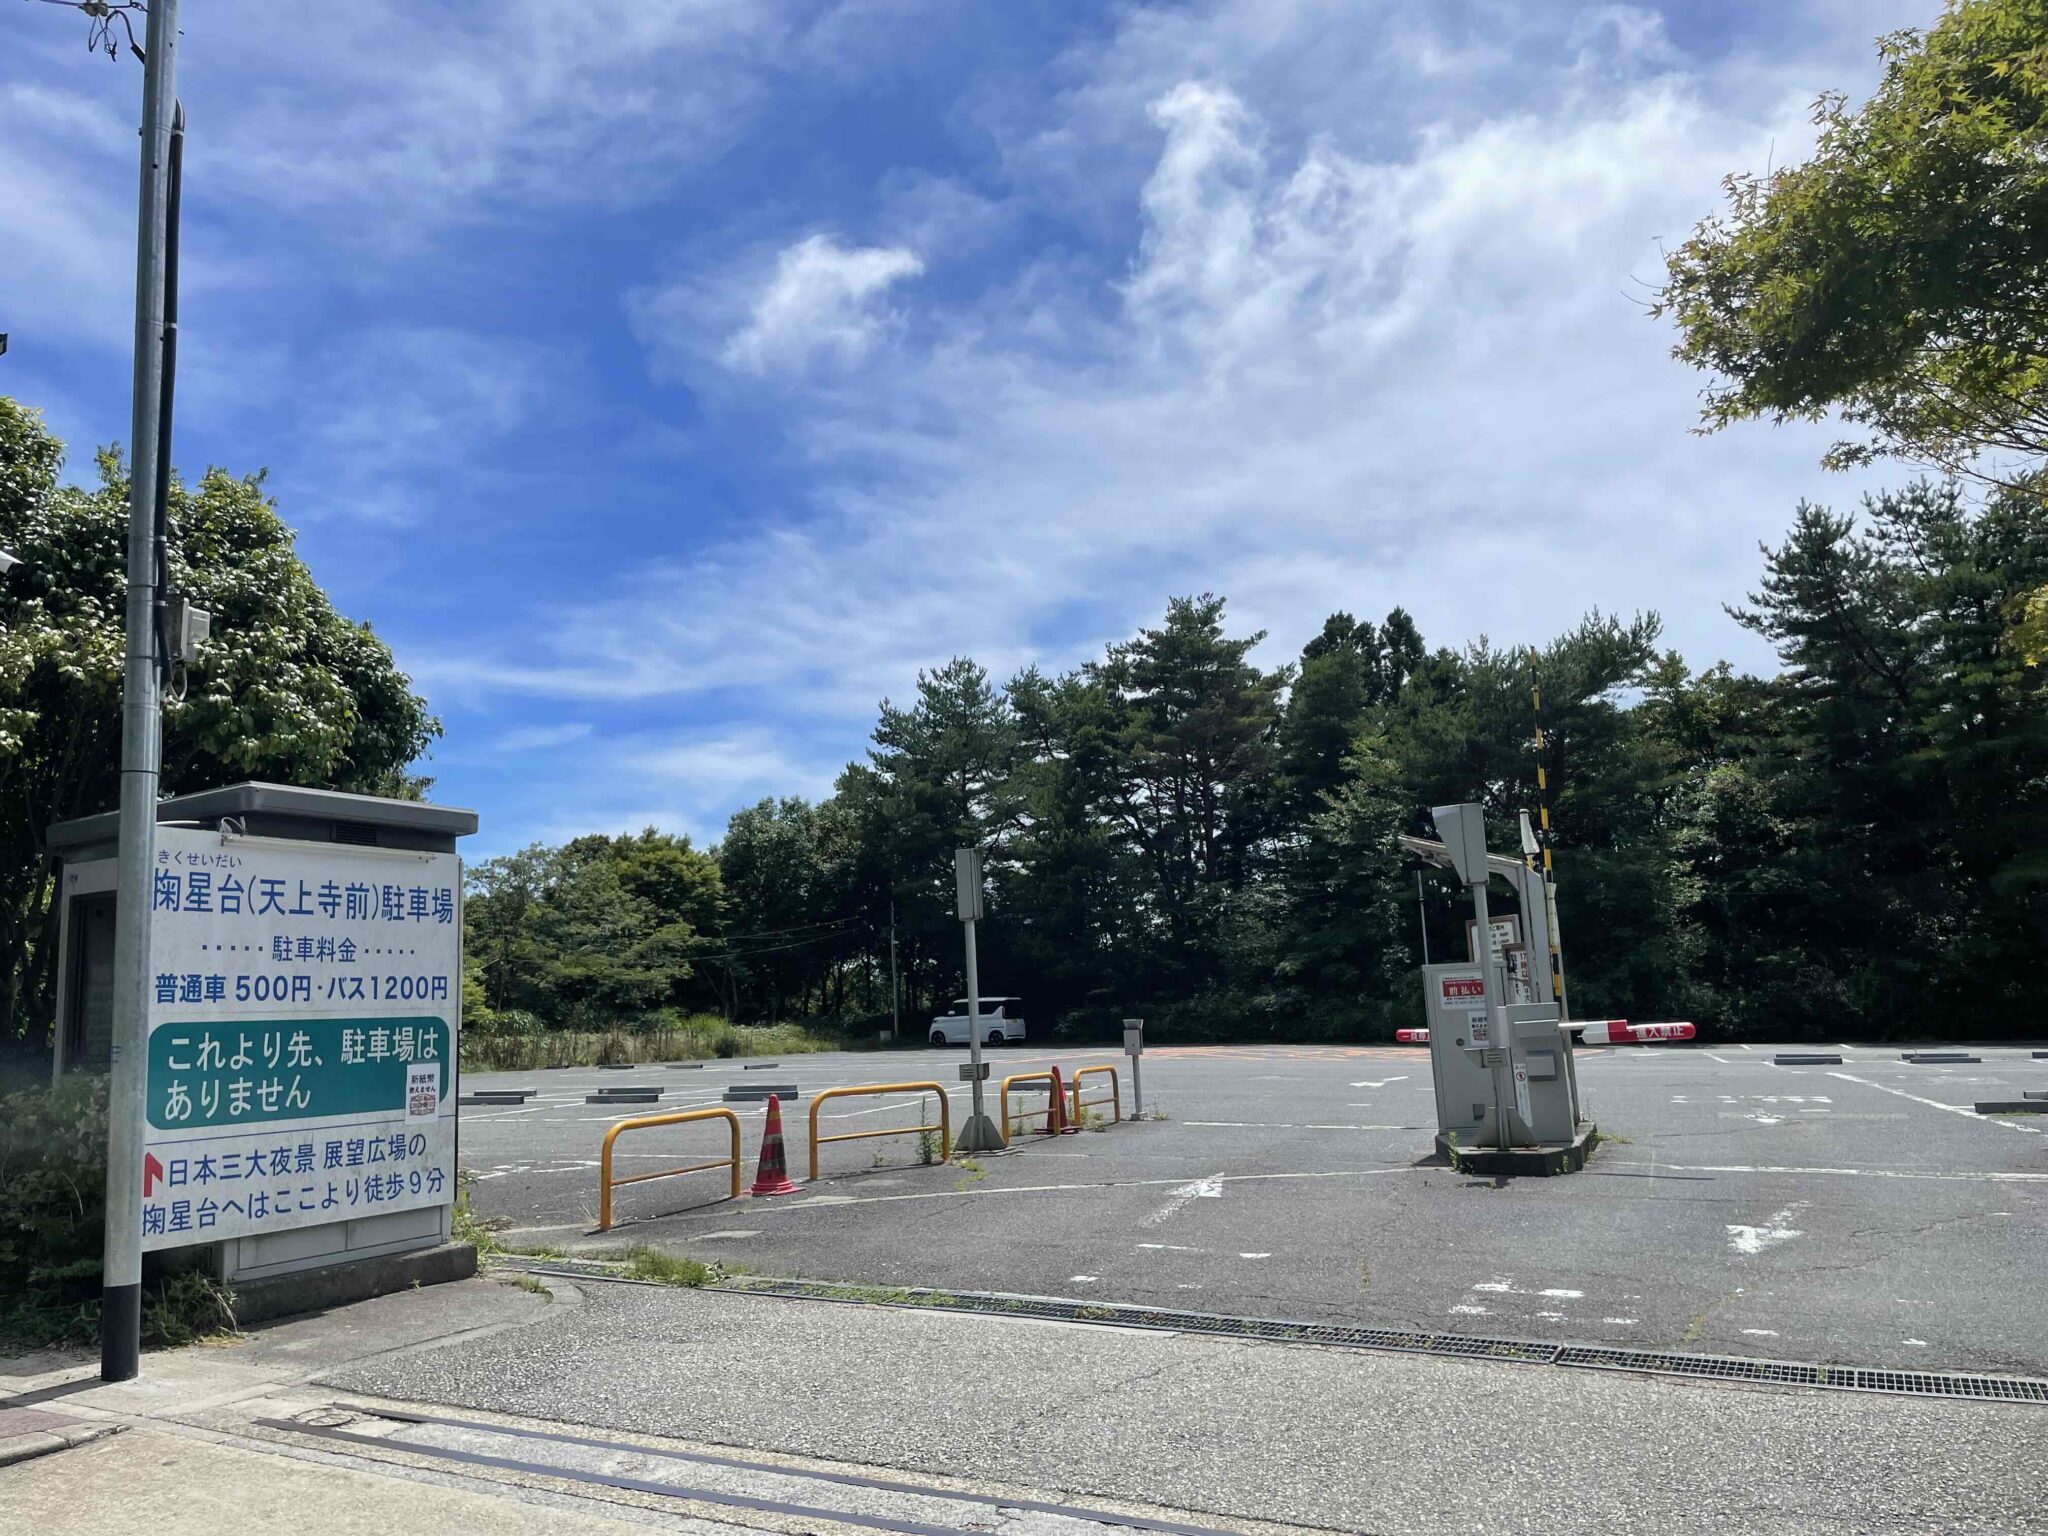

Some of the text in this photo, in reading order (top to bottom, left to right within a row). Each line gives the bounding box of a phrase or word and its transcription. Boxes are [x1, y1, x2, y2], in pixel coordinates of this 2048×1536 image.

[158, 849, 242, 868] きくせいだい
[1636, 1024, 1685, 1038] 進入禁止
[164, 1074, 312, 1121] ありません
